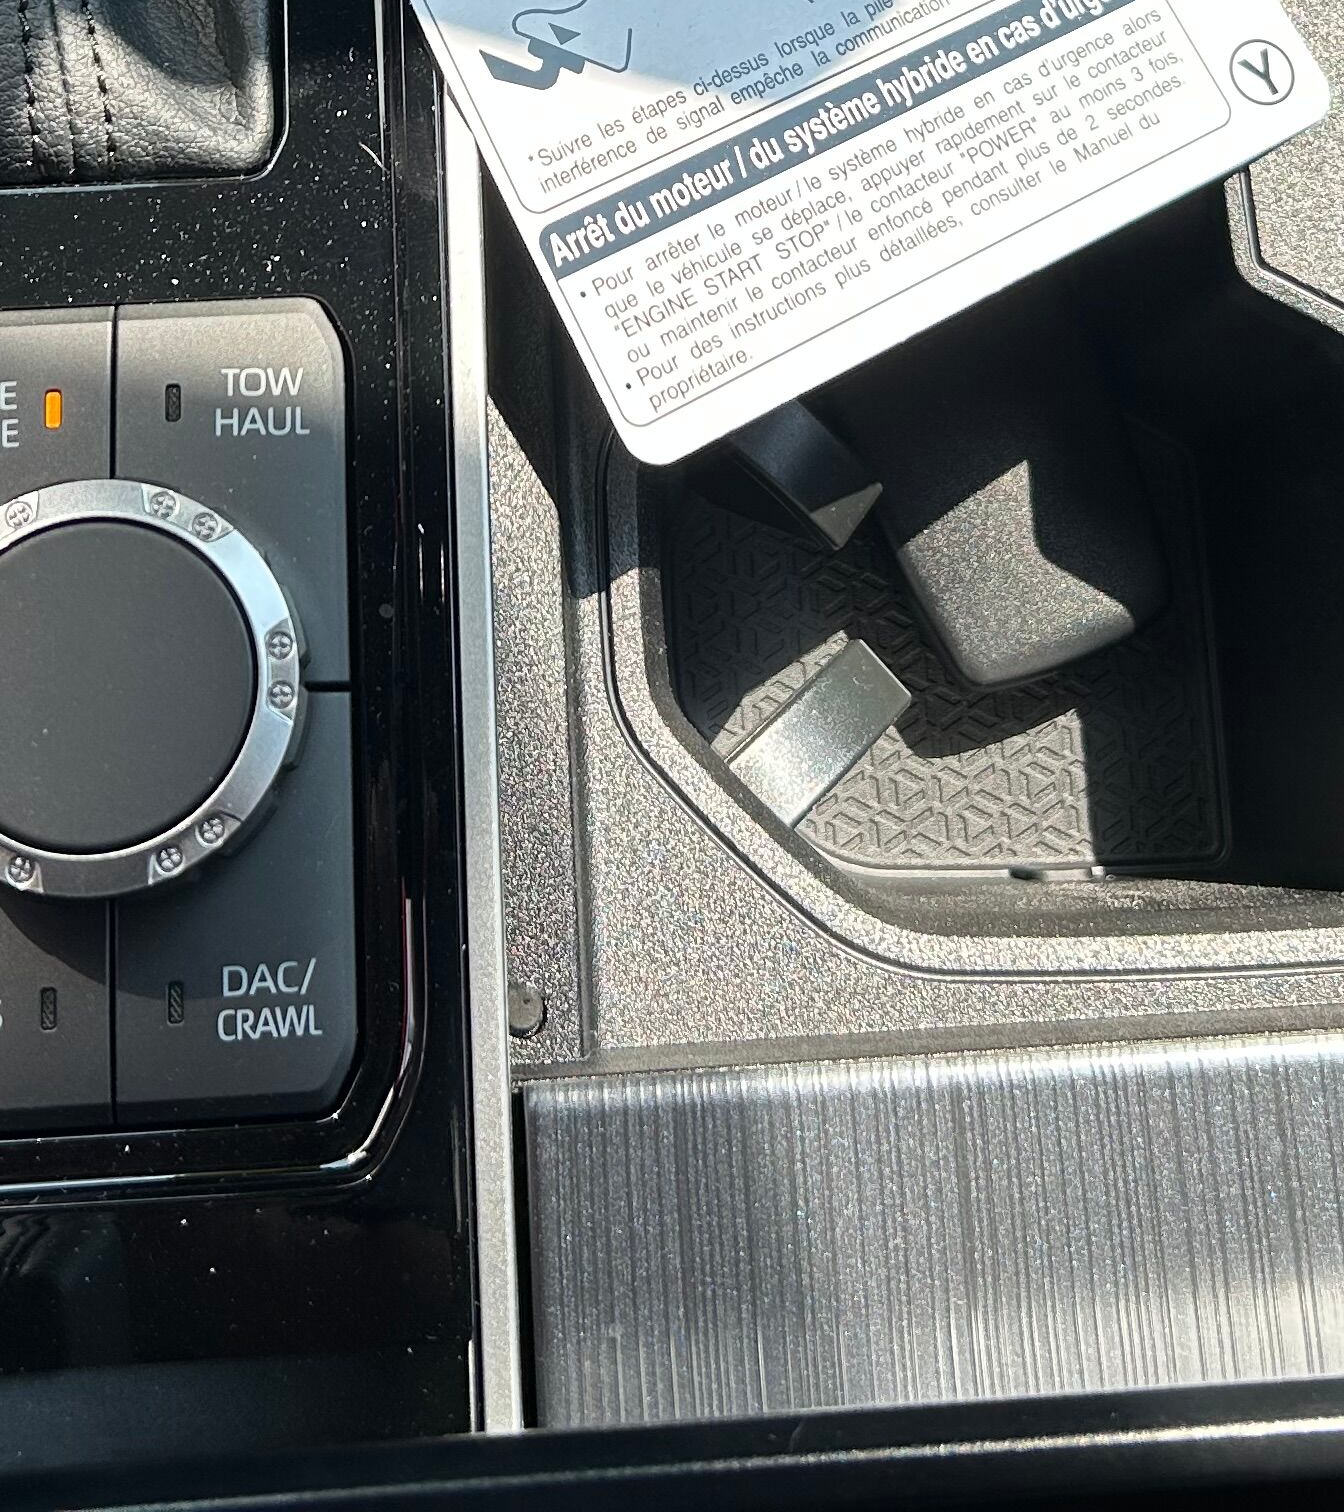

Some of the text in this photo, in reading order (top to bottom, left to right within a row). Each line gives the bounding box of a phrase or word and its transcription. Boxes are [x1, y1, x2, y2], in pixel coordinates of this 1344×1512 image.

[596, 118, 625, 139] les
[631, 90, 687, 124] étapes
[692, 52, 769, 96] ci-dessus
[773, 22, 835, 58] lorsque
[839, 10, 861, 27] la
[1236, 47, 1278, 95] Y
[539, 139, 637, 193] interférence
[645, 125, 668, 144] de
[675, 94, 725, 130] signal
[729, 62, 804, 105] empêche
[809, 50, 831, 67] la
[549, 213, 616, 267] Arrêt
[614, 199, 651, 235] du
[648, 158, 734, 218] moteur
[749, 136, 785, 169] du
[783, 91, 881, 154] système
[874, 49, 967, 107] hybride
[965, 35, 1000, 64] en
[993, 15, 1041, 49] cas
[603, 30, 1166, 319] que le véhicule se déplace, appuyer rapidement sur le contacteur
[221, 367, 304, 396] TOW
[213, 405, 311, 437] HAUL
[222, 958, 318, 996] DAC/
[217, 1005, 324, 1041] CRAWL
